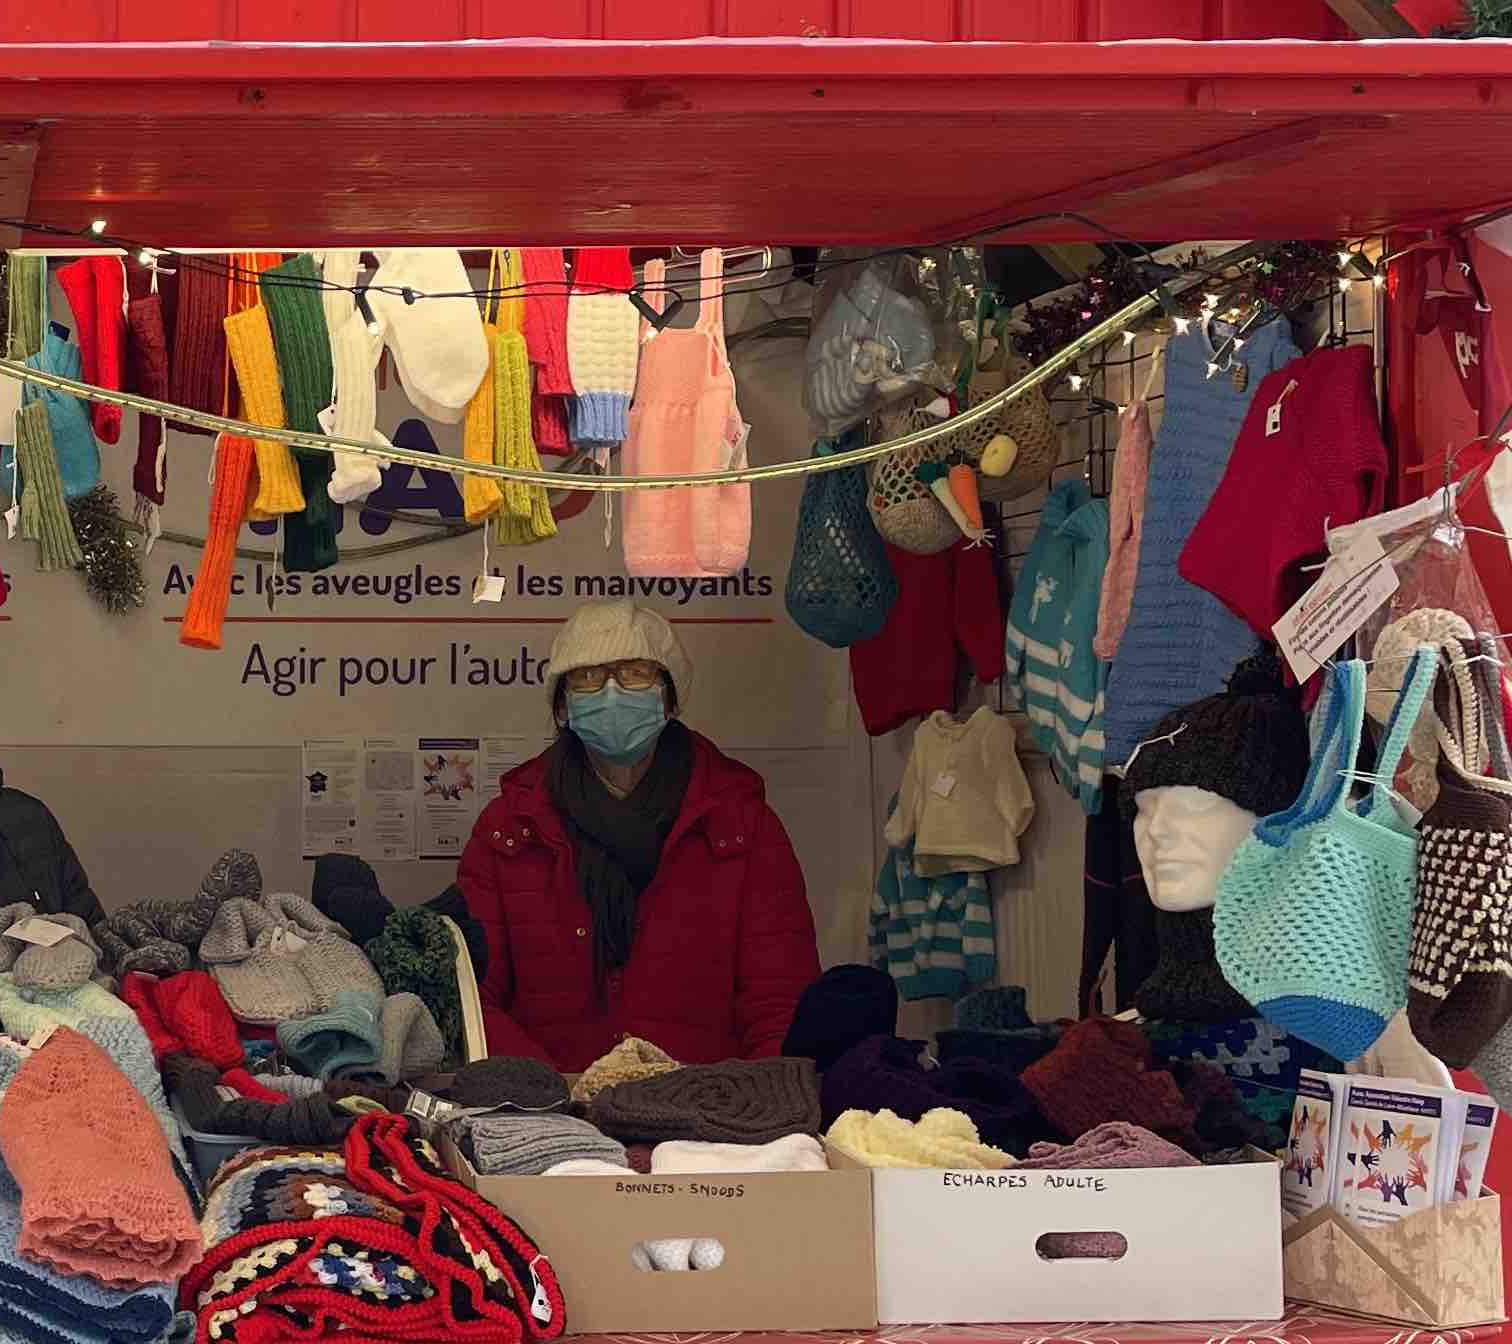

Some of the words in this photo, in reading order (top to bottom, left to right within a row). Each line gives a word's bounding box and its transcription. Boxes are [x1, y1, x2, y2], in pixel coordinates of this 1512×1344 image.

[163, 564, 245, 594] Ac
[312, 564, 461, 603] aveugles
[517, 565, 563, 596] les
[241, 642, 326, 697] Agir
[339, 656, 437, 697] pour
[615, 1182, 675, 1195] BONNETS
[689, 1183, 745, 1198] SNOODS
[943, 1172, 1028, 1188] ECHARPES
[1044, 1174, 1108, 1191] ADULTE
